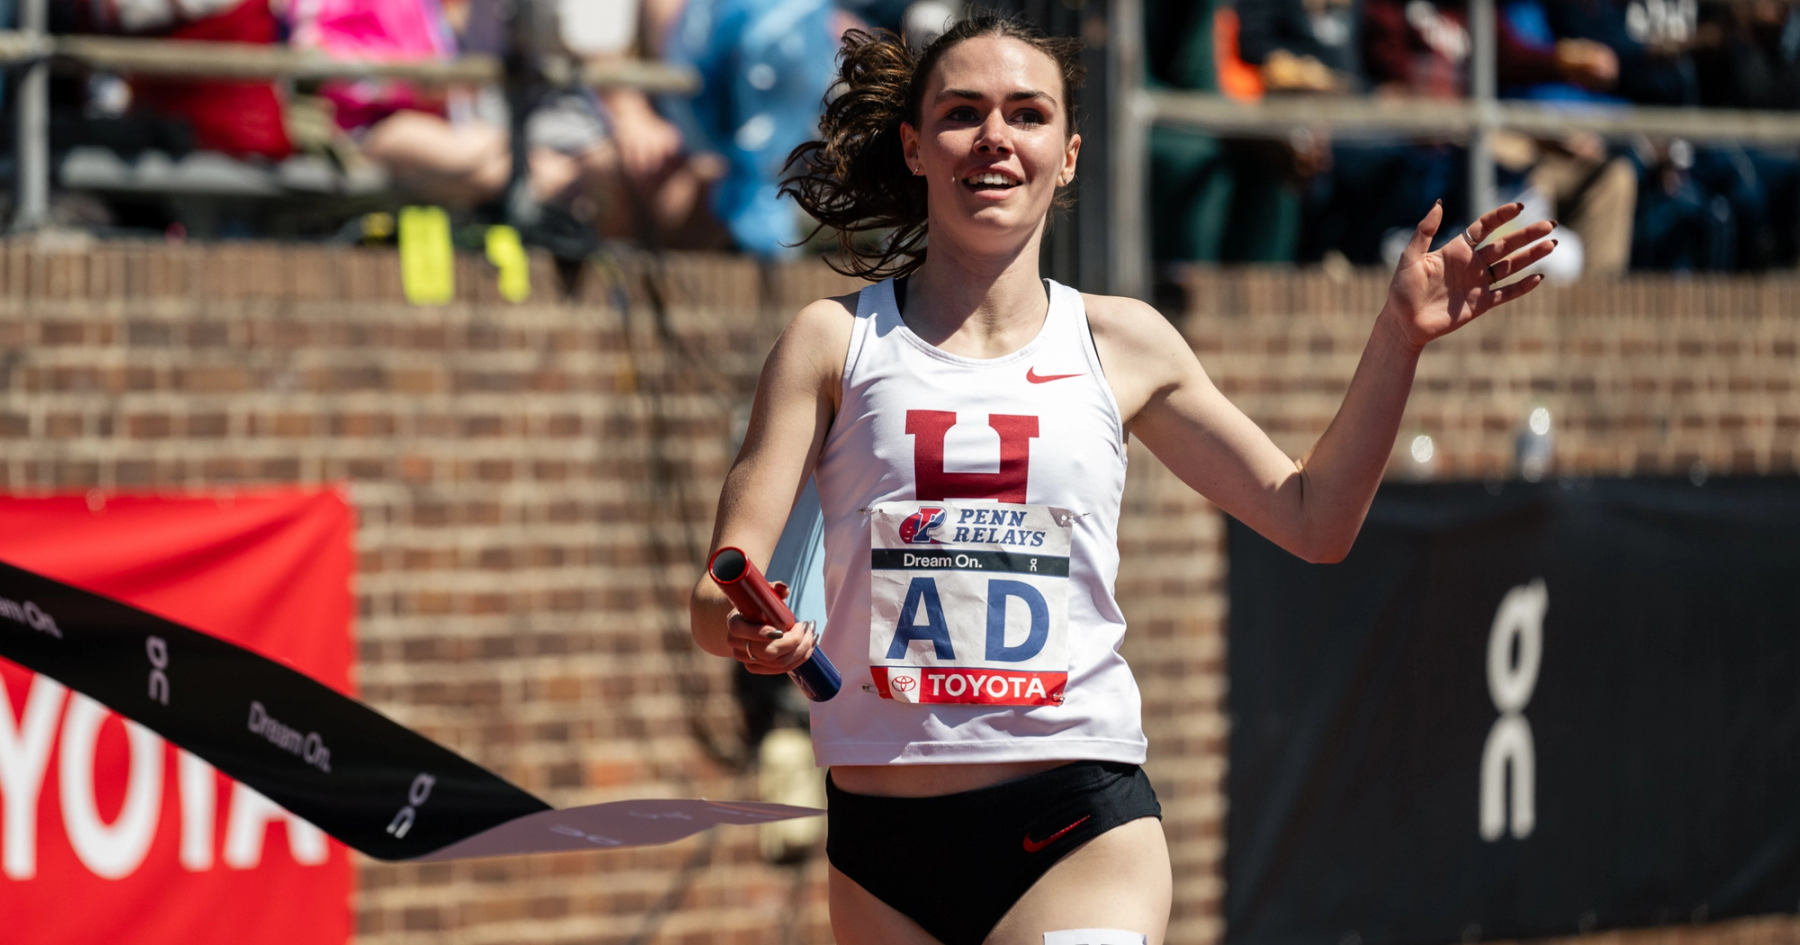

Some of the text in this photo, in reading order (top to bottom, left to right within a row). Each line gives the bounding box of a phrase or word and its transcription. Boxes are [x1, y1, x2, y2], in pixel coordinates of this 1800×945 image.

[905, 409, 1040, 504] H
[957, 508, 1028, 527] PENN
[952, 526, 1046, 547] RELAYS
[903, 553, 983, 568] Dream On.
[885, 576, 1050, 664] A D
[928, 673, 1047, 699] TOYOTA
[248, 700, 331, 773] Dream On.
